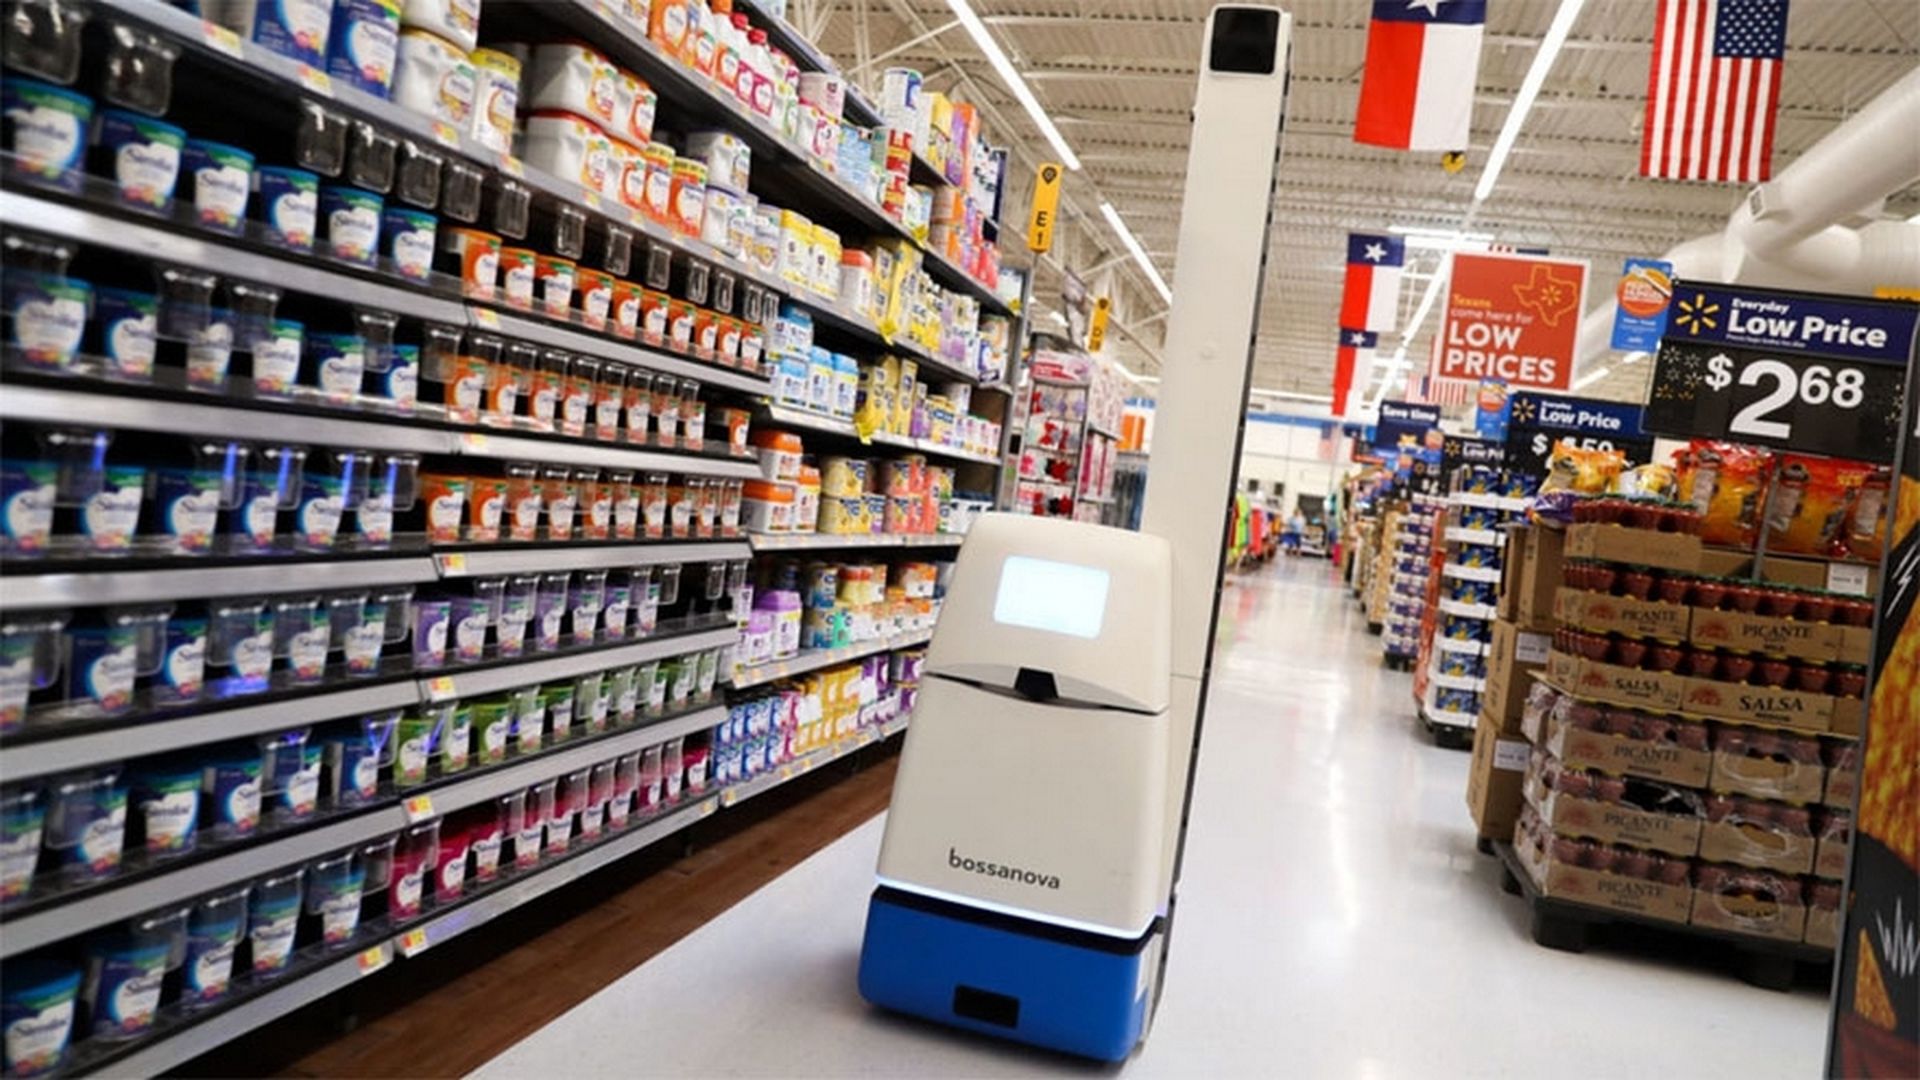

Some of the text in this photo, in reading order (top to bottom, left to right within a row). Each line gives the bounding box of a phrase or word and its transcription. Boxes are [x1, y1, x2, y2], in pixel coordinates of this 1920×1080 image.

[1035, 211, 1047, 227] E
[1452, 294, 1492, 308] Texans
[1732, 297, 1790, 315] Everyday
[1450, 308, 1534, 325] come here for
[1449, 320, 1522, 350] LOW
[1727, 309, 1797, 338] Low
[1801, 316, 1887, 348] Price
[1445, 349, 1556, 384] PRICES
[1382, 405, 1437, 421] Save time
[1539, 406, 1621, 430] Low Price
[1531, 432, 1549, 455] $
[1622, 609, 1678, 623] PICANTE
[1743, 624, 1812, 639] PICANTE
[1615, 677, 1661, 693] SALSA
[1739, 695, 1804, 712] SALSA
[1614, 744, 1680, 761] PICANTE
[1604, 810, 1671, 830] PICANTE
[948, 846, 1061, 890] bossanova
[1598, 879, 1664, 896] PICANTE
